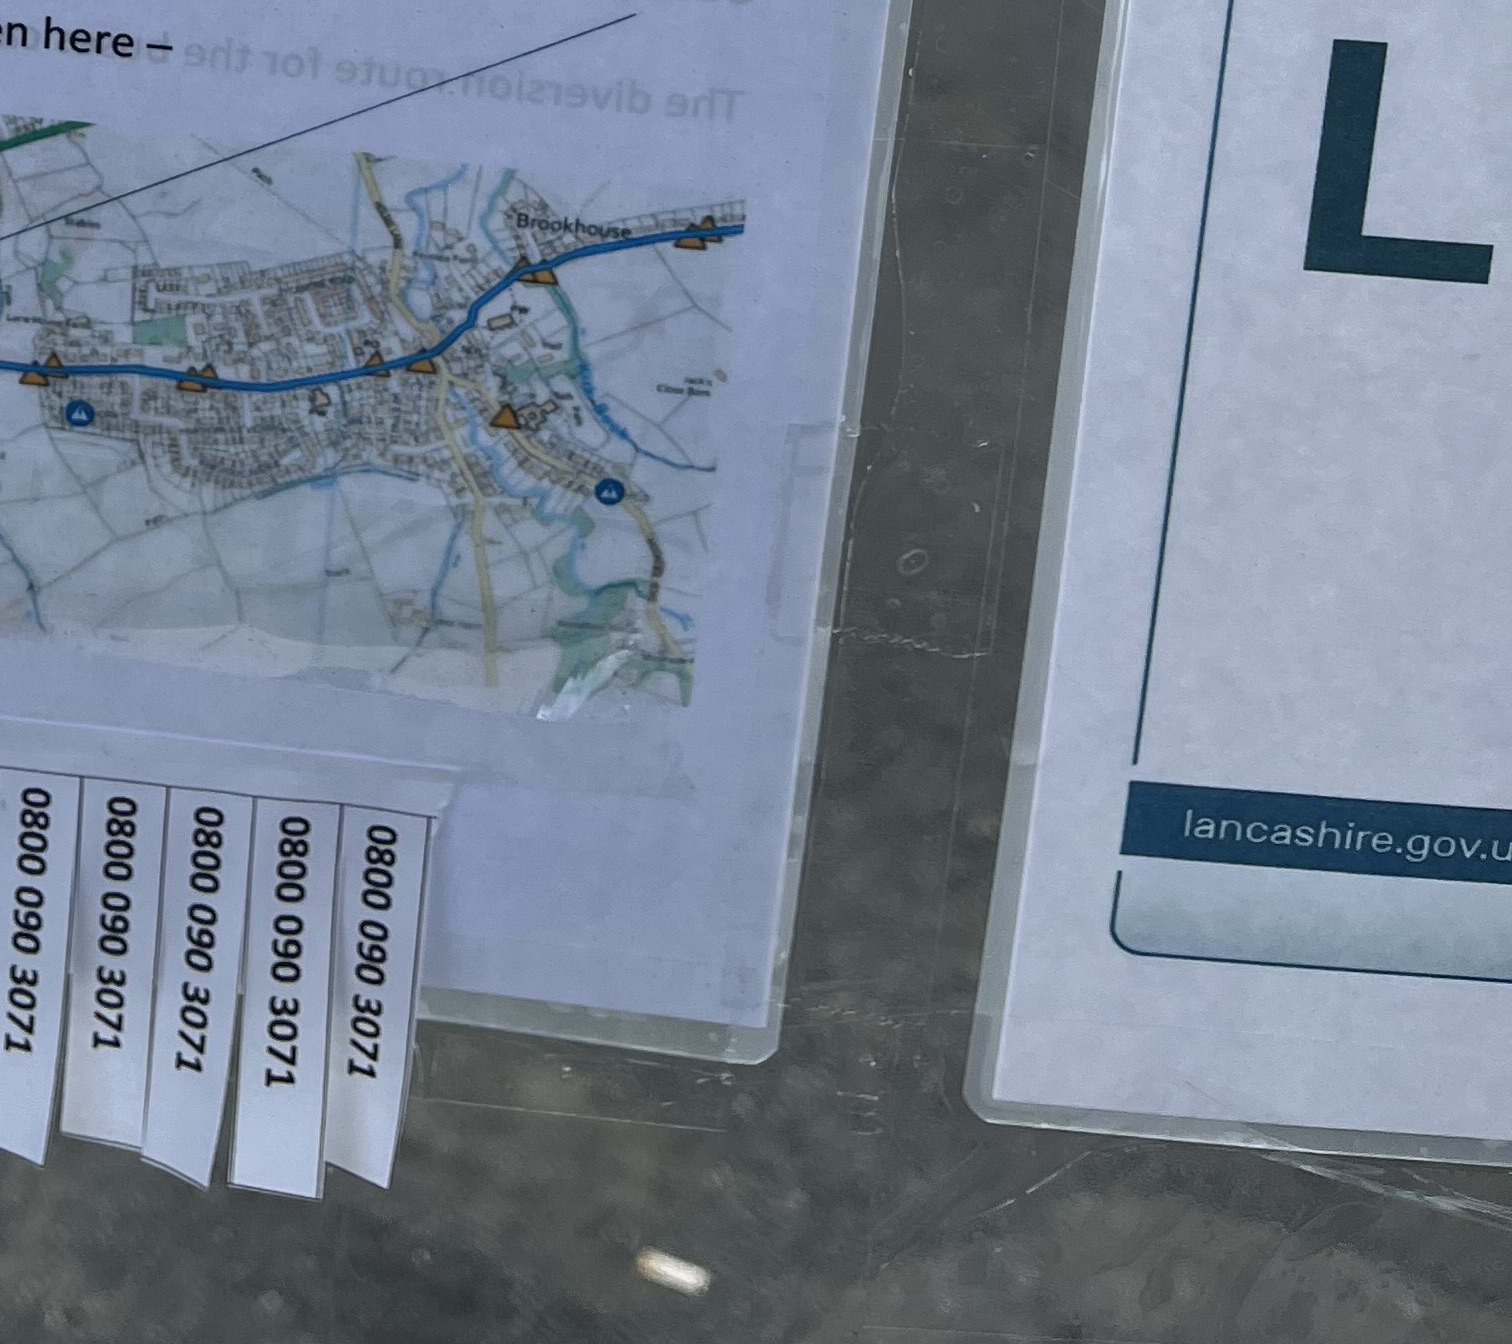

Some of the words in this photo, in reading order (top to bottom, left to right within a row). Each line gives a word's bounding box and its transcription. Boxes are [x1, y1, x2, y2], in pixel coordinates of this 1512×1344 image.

[44, 16, 134, 58] here
[516, 212, 633, 240] Brookhouse
[18, 788, 51, 875] 0800
[276, 817, 310, 902] 0800
[1183, 809, 1512, 864] lancashire.gov.u
[12, 886, 44, 954] 090
[271, 915, 303, 982] 090
[5, 965, 38, 1052] 3071
[266, 996, 299, 1087] 3071
